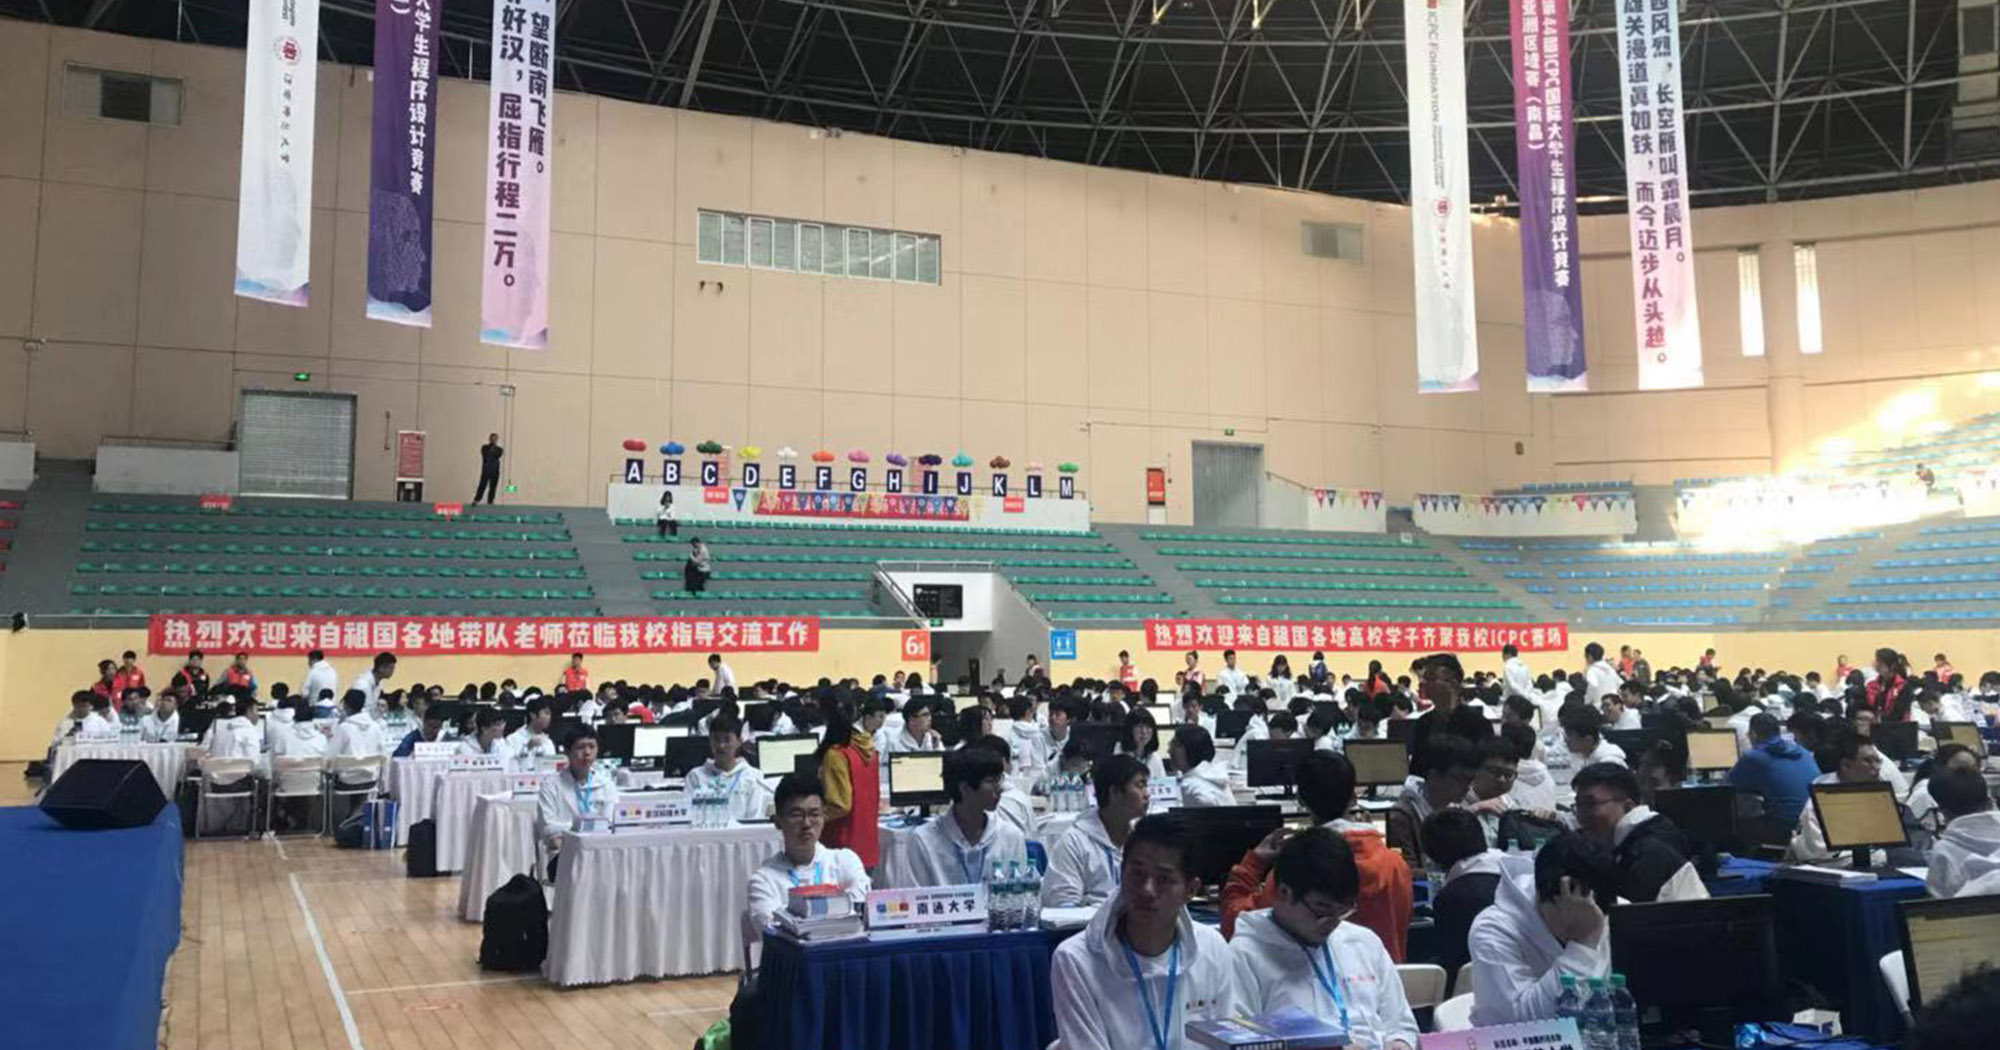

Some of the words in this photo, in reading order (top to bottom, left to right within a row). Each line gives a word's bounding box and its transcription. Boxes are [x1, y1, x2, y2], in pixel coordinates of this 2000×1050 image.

[1427, 11, 1438, 40] ICPC
[494, 0, 526, 287] 好汉，屈指行程二万。
[627, 462, 641, 481] A
[665, 464, 678, 482] B
[703, 465, 716, 484] C
[744, 467, 757, 485] D
[782, 468, 793, 487] E
[818, 470, 829, 488] F
[852, 471, 864, 490] G
[888, 472, 900, 491] H
[928, 474, 933, 491] I
[959, 475, 968, 492] J
[995, 477, 1006, 494] K
[1030, 478, 1038, 495] L
[1062, 479, 1072, 497] M
[164, 619, 808, 648] 热烈欢迎来自祖国各地带队老师莅临我校指导交流工作
[1154, 624, 1561, 648] 热烈欢迎来自祖国各地高校学子齐聚我校ICPC赛场
[906, 635, 918, 655] 6
[917, 898, 975, 915] 南通大学
